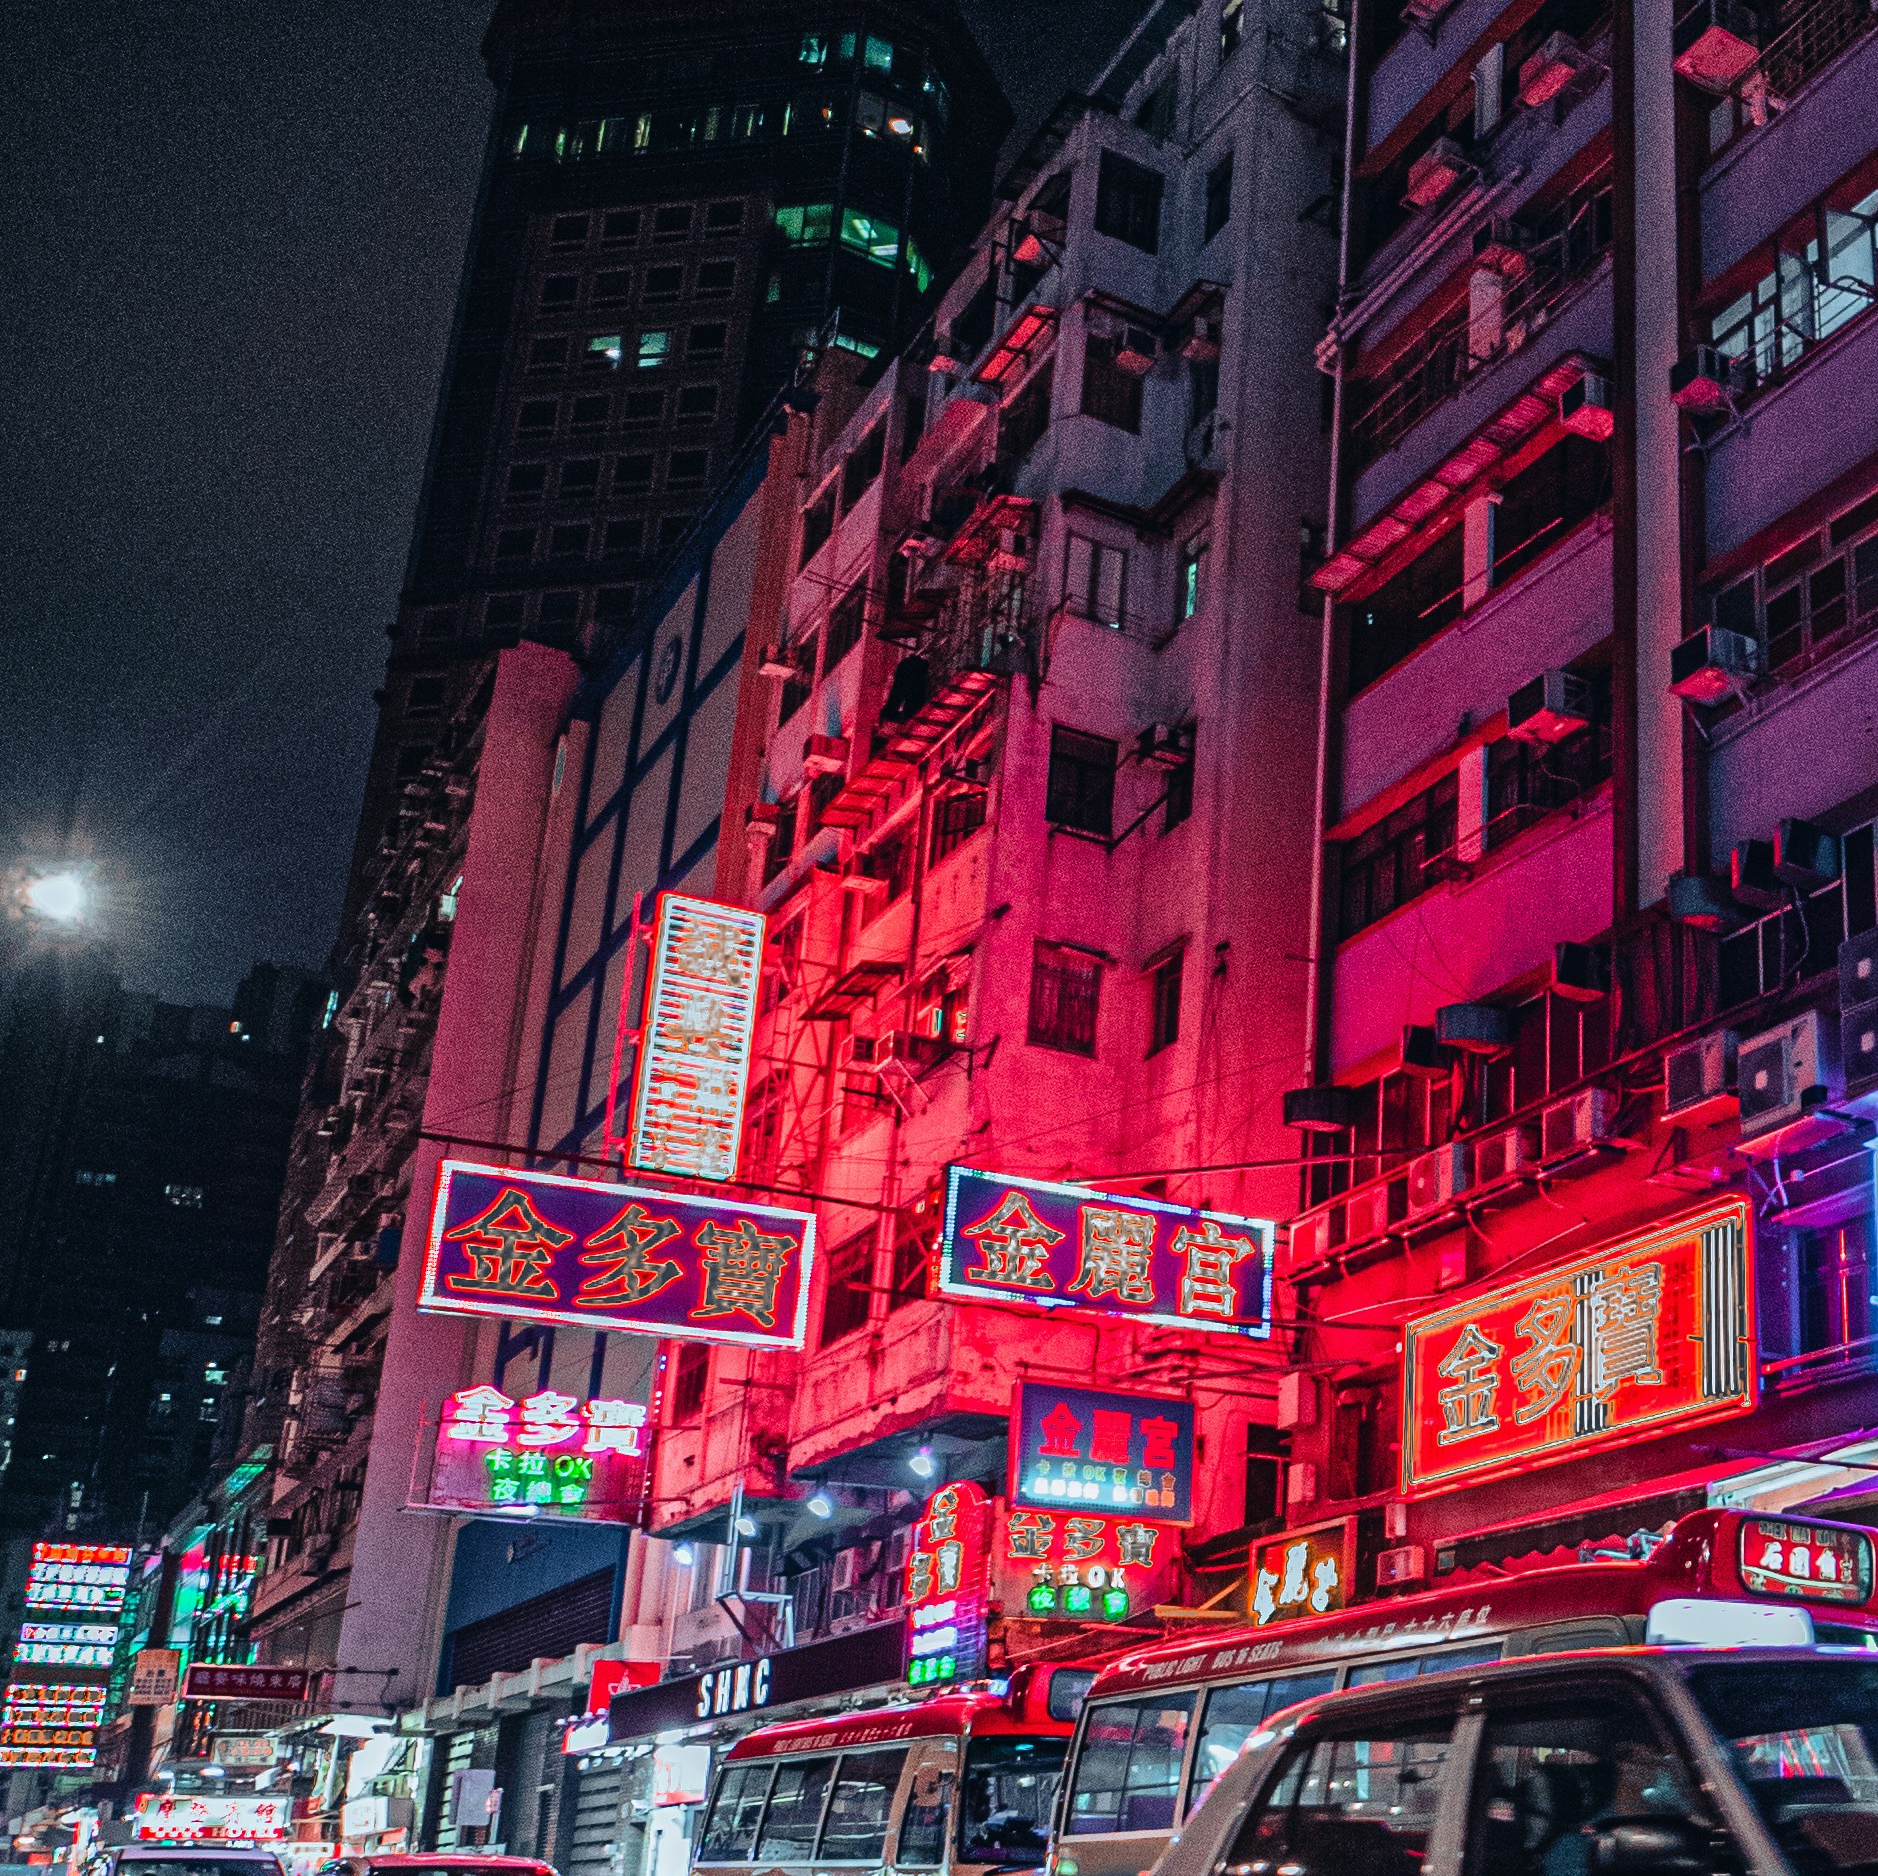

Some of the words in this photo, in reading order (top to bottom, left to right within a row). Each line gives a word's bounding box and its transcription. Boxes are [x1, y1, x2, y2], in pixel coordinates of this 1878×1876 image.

[444, 1186, 799, 1329] 金多寶
[963, 1190, 1256, 1319] 金麗宮
[1437, 1261, 1663, 1447] 金多寶
[449, 1384, 647, 1457] 金多寶
[1038, 1401, 1179, 1470] 金麗宮
[485, 1446, 594, 1480] 卡拉OK
[1008, 1512, 1160, 1568] 金多寶
[1031, 1562, 1127, 1590] 卡拉OK
[1175, 1653, 1208, 1676] LIGHT
[1211, 1648, 1235, 1670] BUS
[1250, 1640, 1284, 1663] SEATS
